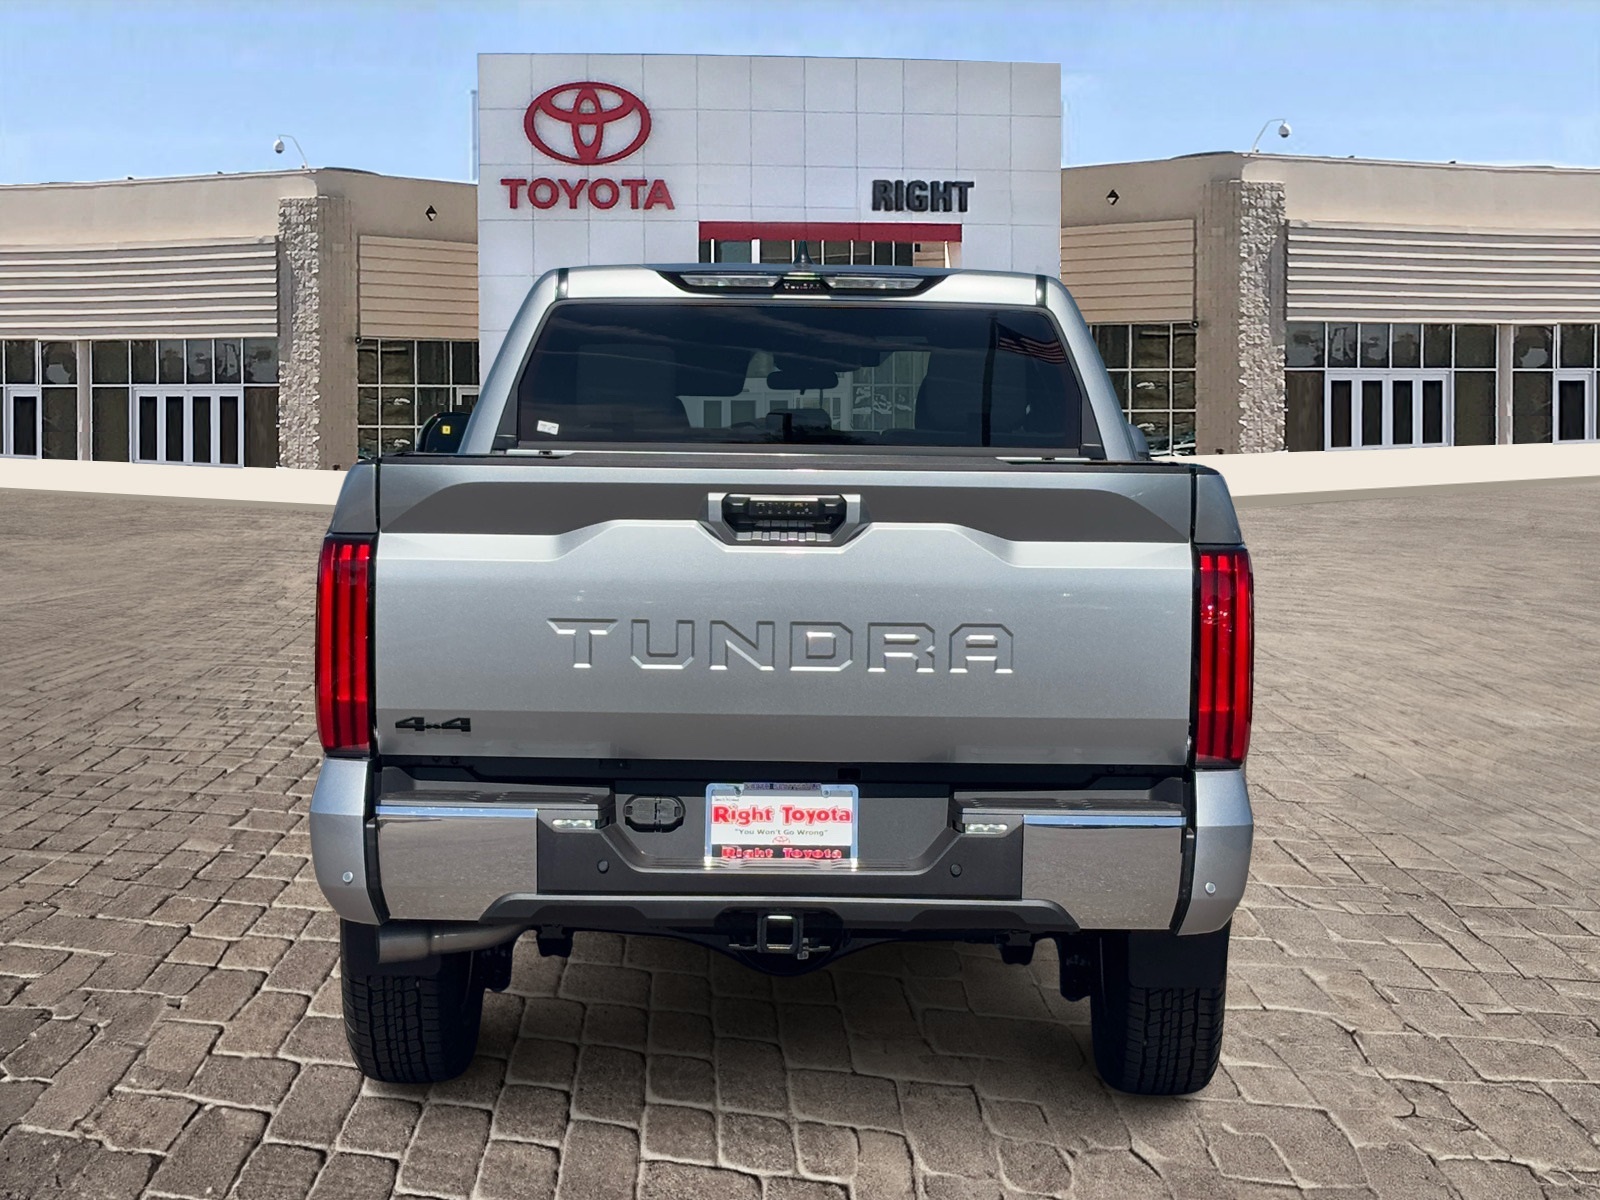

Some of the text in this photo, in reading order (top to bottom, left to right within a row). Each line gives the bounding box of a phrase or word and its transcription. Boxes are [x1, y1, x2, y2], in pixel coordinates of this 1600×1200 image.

[500, 179, 675, 210] TOYOTA
[872, 180, 975, 213] RIGHT
[547, 617, 1014, 675] TUNDRA
[712, 805, 852, 825] Right Toyota
[721, 846, 842, 859] Right Toyota
